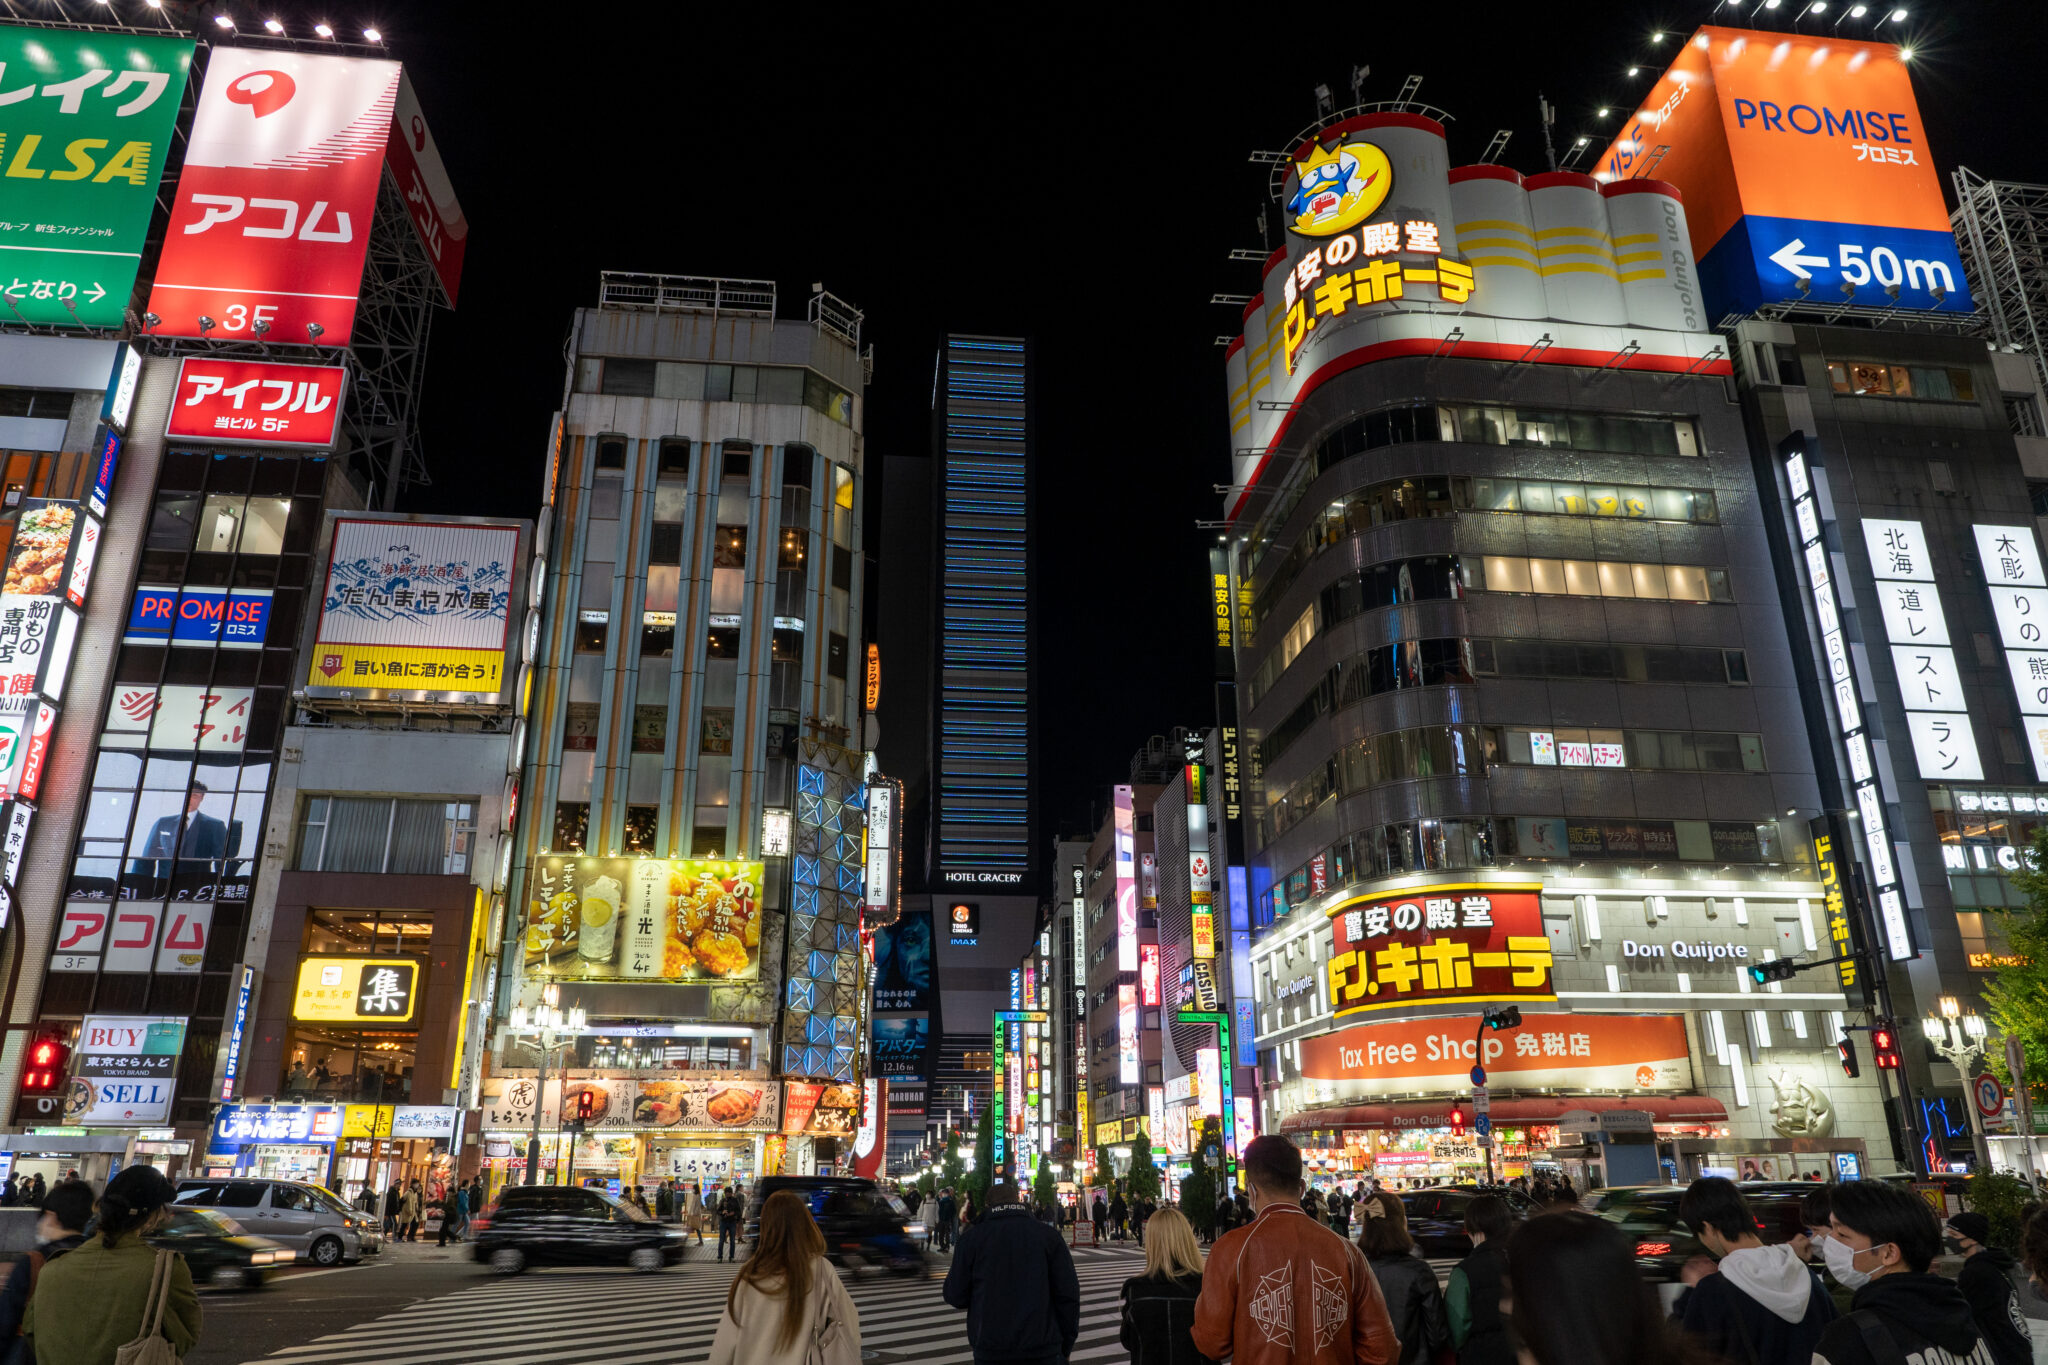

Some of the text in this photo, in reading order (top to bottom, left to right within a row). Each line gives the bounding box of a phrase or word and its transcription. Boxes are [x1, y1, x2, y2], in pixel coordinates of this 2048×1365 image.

[1734, 98, 1912, 144] PROMISE
[0, 133, 151, 186] LSA
[1852, 143, 1918, 166] プロミス
[184, 194, 353, 243] アコム
[406, 168, 442, 262] アコム
[35, 224, 114, 237] 新生フィナンシャル
[1663, 200, 1697, 330] Don Quijote
[1840, 244, 1956, 293] 50m
[222, 305, 278, 331] 3F
[186, 375, 331, 413] アイフル
[214, 416, 289, 432] 当ビル 5F
[99, 437, 117, 487] PROMISE
[381, 562, 465, 578] 海鮮居酒屋
[140, 598, 263, 622] PROMISE
[342, 587, 492, 610] だんまや水産
[1214, 574, 1230, 647] 驚安の殿堂
[0, 608, 26, 664] 専門店
[20, 601, 50, 656] 粉もの
[210, 623, 257, 636] プロミス
[1818, 592, 1853, 723] KIBORI
[1884, 528, 1958, 771] 北海道レストラン
[325, 658, 340, 668] B1
[353, 659, 497, 681] 旨い魚に酒が合う!
[25, 739, 43, 783] アコム
[1561, 745, 1622, 766] アイドル ステージ
[22, 784, 33, 794] 3F
[1959, 796, 2008, 811] SPICE
[1569, 828, 1600, 844] 販売
[1607, 831, 1637, 842] ブランド
[1643, 832, 1673, 843] 時計
[946, 873, 1022, 883] HOTEL GRACERY
[696, 872, 713, 920] チキンが
[538, 867, 556, 967] レモンサワー
[715, 895, 735, 940] 猛烈に
[1196, 905, 1208, 913] 4F
[1345, 896, 1493, 943] 驚安の殿堂
[59, 912, 205, 951] アコム
[637, 917, 653, 934] 光
[1196, 916, 1211, 944] 麻雀
[1623, 940, 1748, 962] Don Quijote
[64, 958, 87, 969] 3F
[633, 960, 650, 973] 4F
[361, 968, 406, 1012] 集
[876, 990, 917, 998] 奪われるのは
[1195, 962, 1217, 1010] CASINO
[1277, 974, 1313, 999] Don Quijote
[89, 1028, 145, 1047] BUY
[874, 1038, 926, 1054] アバター
[1340, 1033, 1591, 1069] Tax Free Shop 免税店
[883, 1063, 905, 1071] 12.16
[100, 1084, 166, 1104] SELL
[511, 1082, 532, 1107] 虎
[765, 1083, 776, 1114] かつ丼
[888, 1092, 924, 1102] MARUHAN
[995, 1033, 1003, 1151] GODZILLA ROAD
[490, 1110, 545, 1124] とらそ
[1393, 1115, 1451, 1127] Don Quijo
[673, 1158, 731, 1174] とらそば
